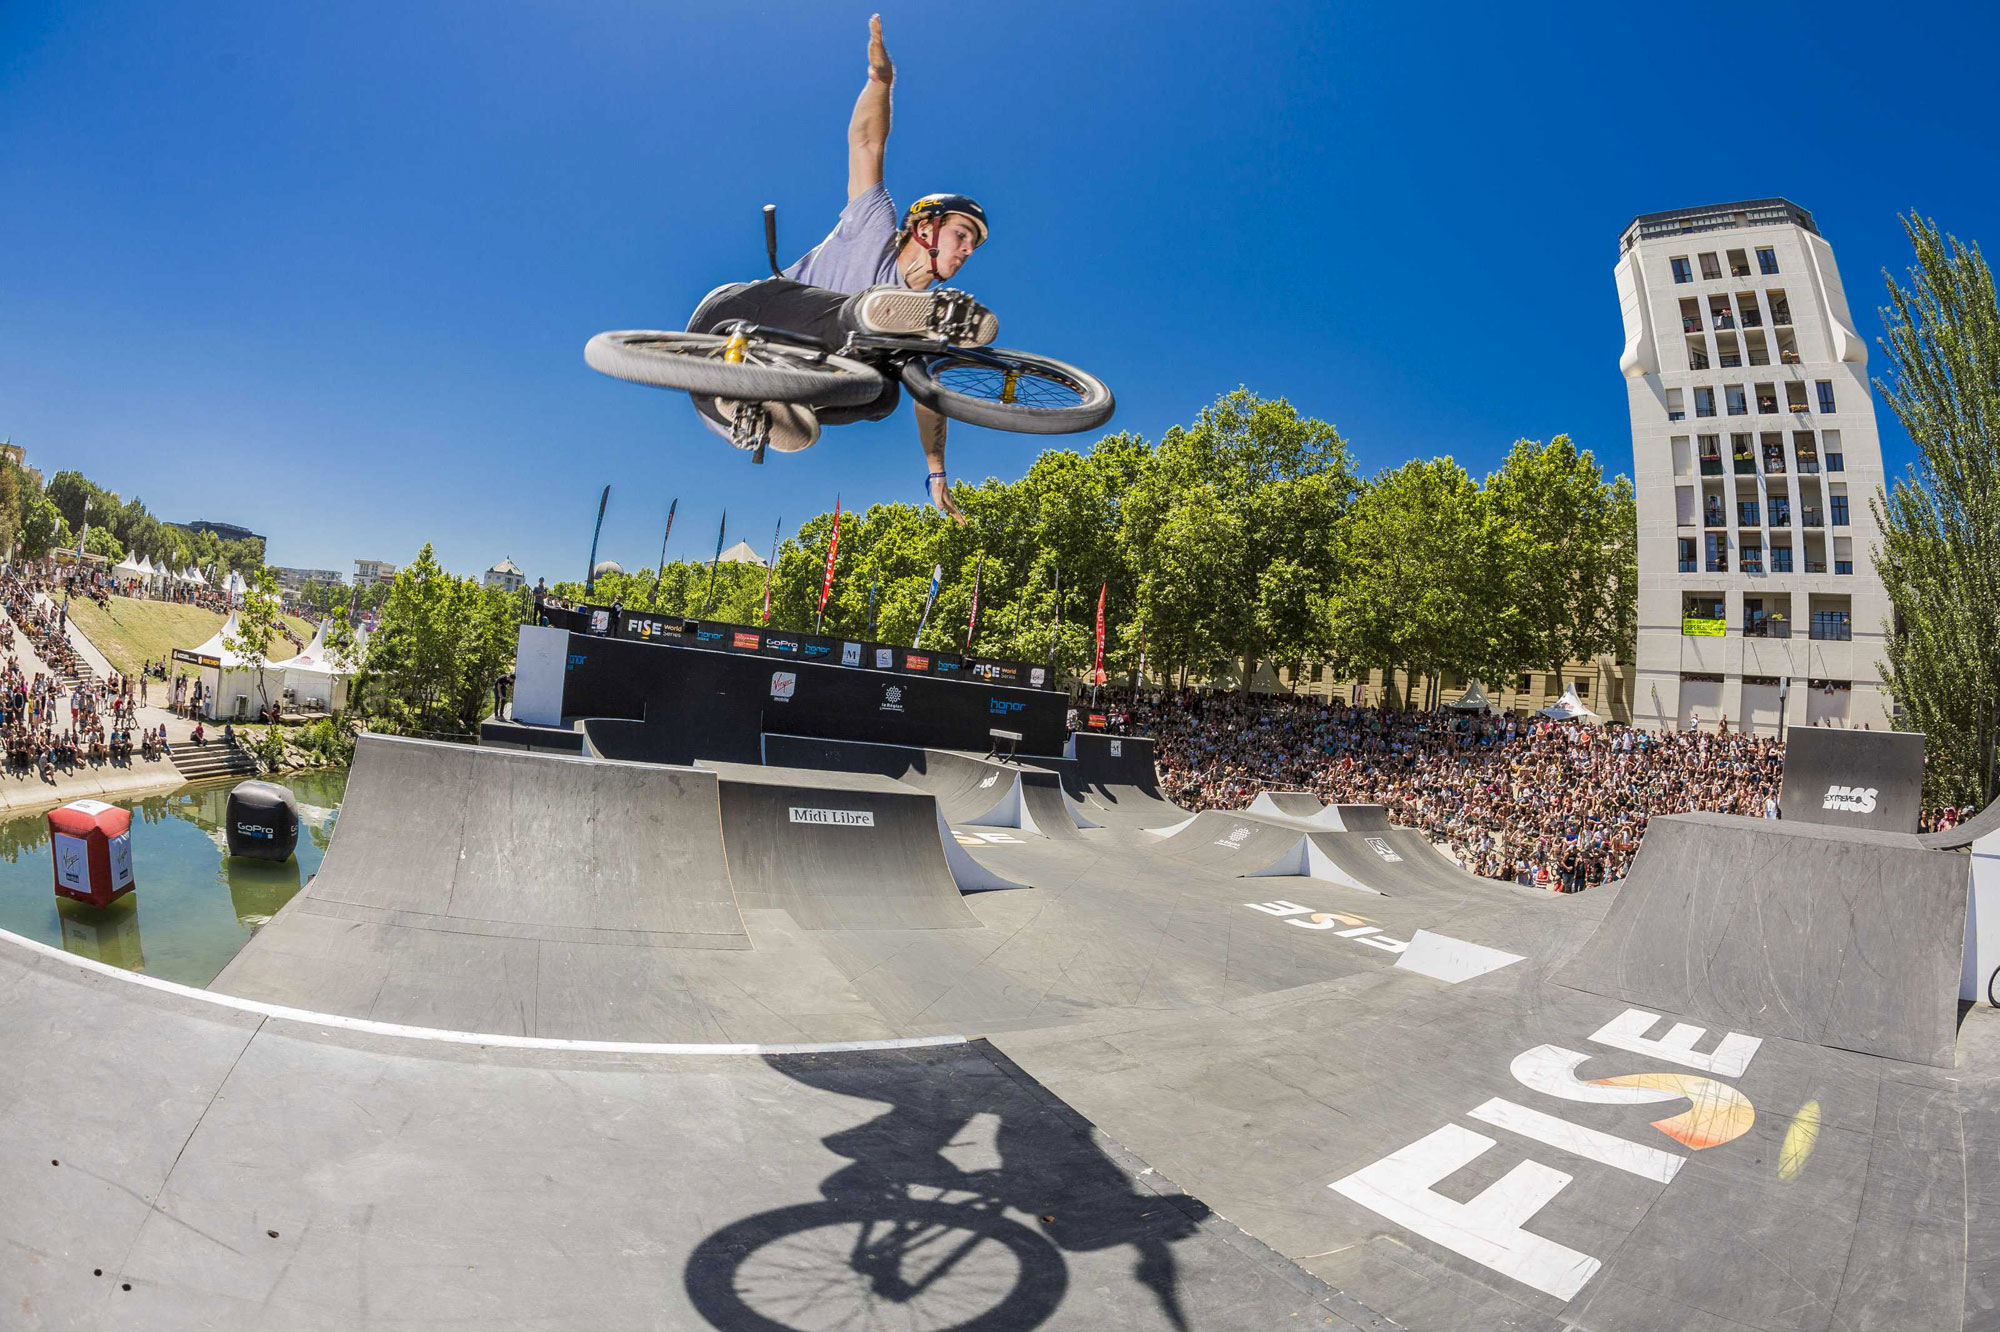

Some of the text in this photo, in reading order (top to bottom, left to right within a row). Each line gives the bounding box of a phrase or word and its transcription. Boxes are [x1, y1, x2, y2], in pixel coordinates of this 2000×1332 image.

[628, 619, 662, 637] FISE
[663, 624, 683, 632] World
[697, 629, 723, 639] honor
[766, 638, 798, 648] GoPro
[972, 663, 1000, 679] FISE
[773, 672, 794, 693] Virgin
[990, 697, 1026, 711] honor
[1822, 785, 1879, 813] MCS
[793, 809, 870, 824] Midi Libre
[237, 821, 274, 834] GoPro
[1243, 900, 1411, 954] FISE
[1327, 1008, 1764, 1302] FISE
